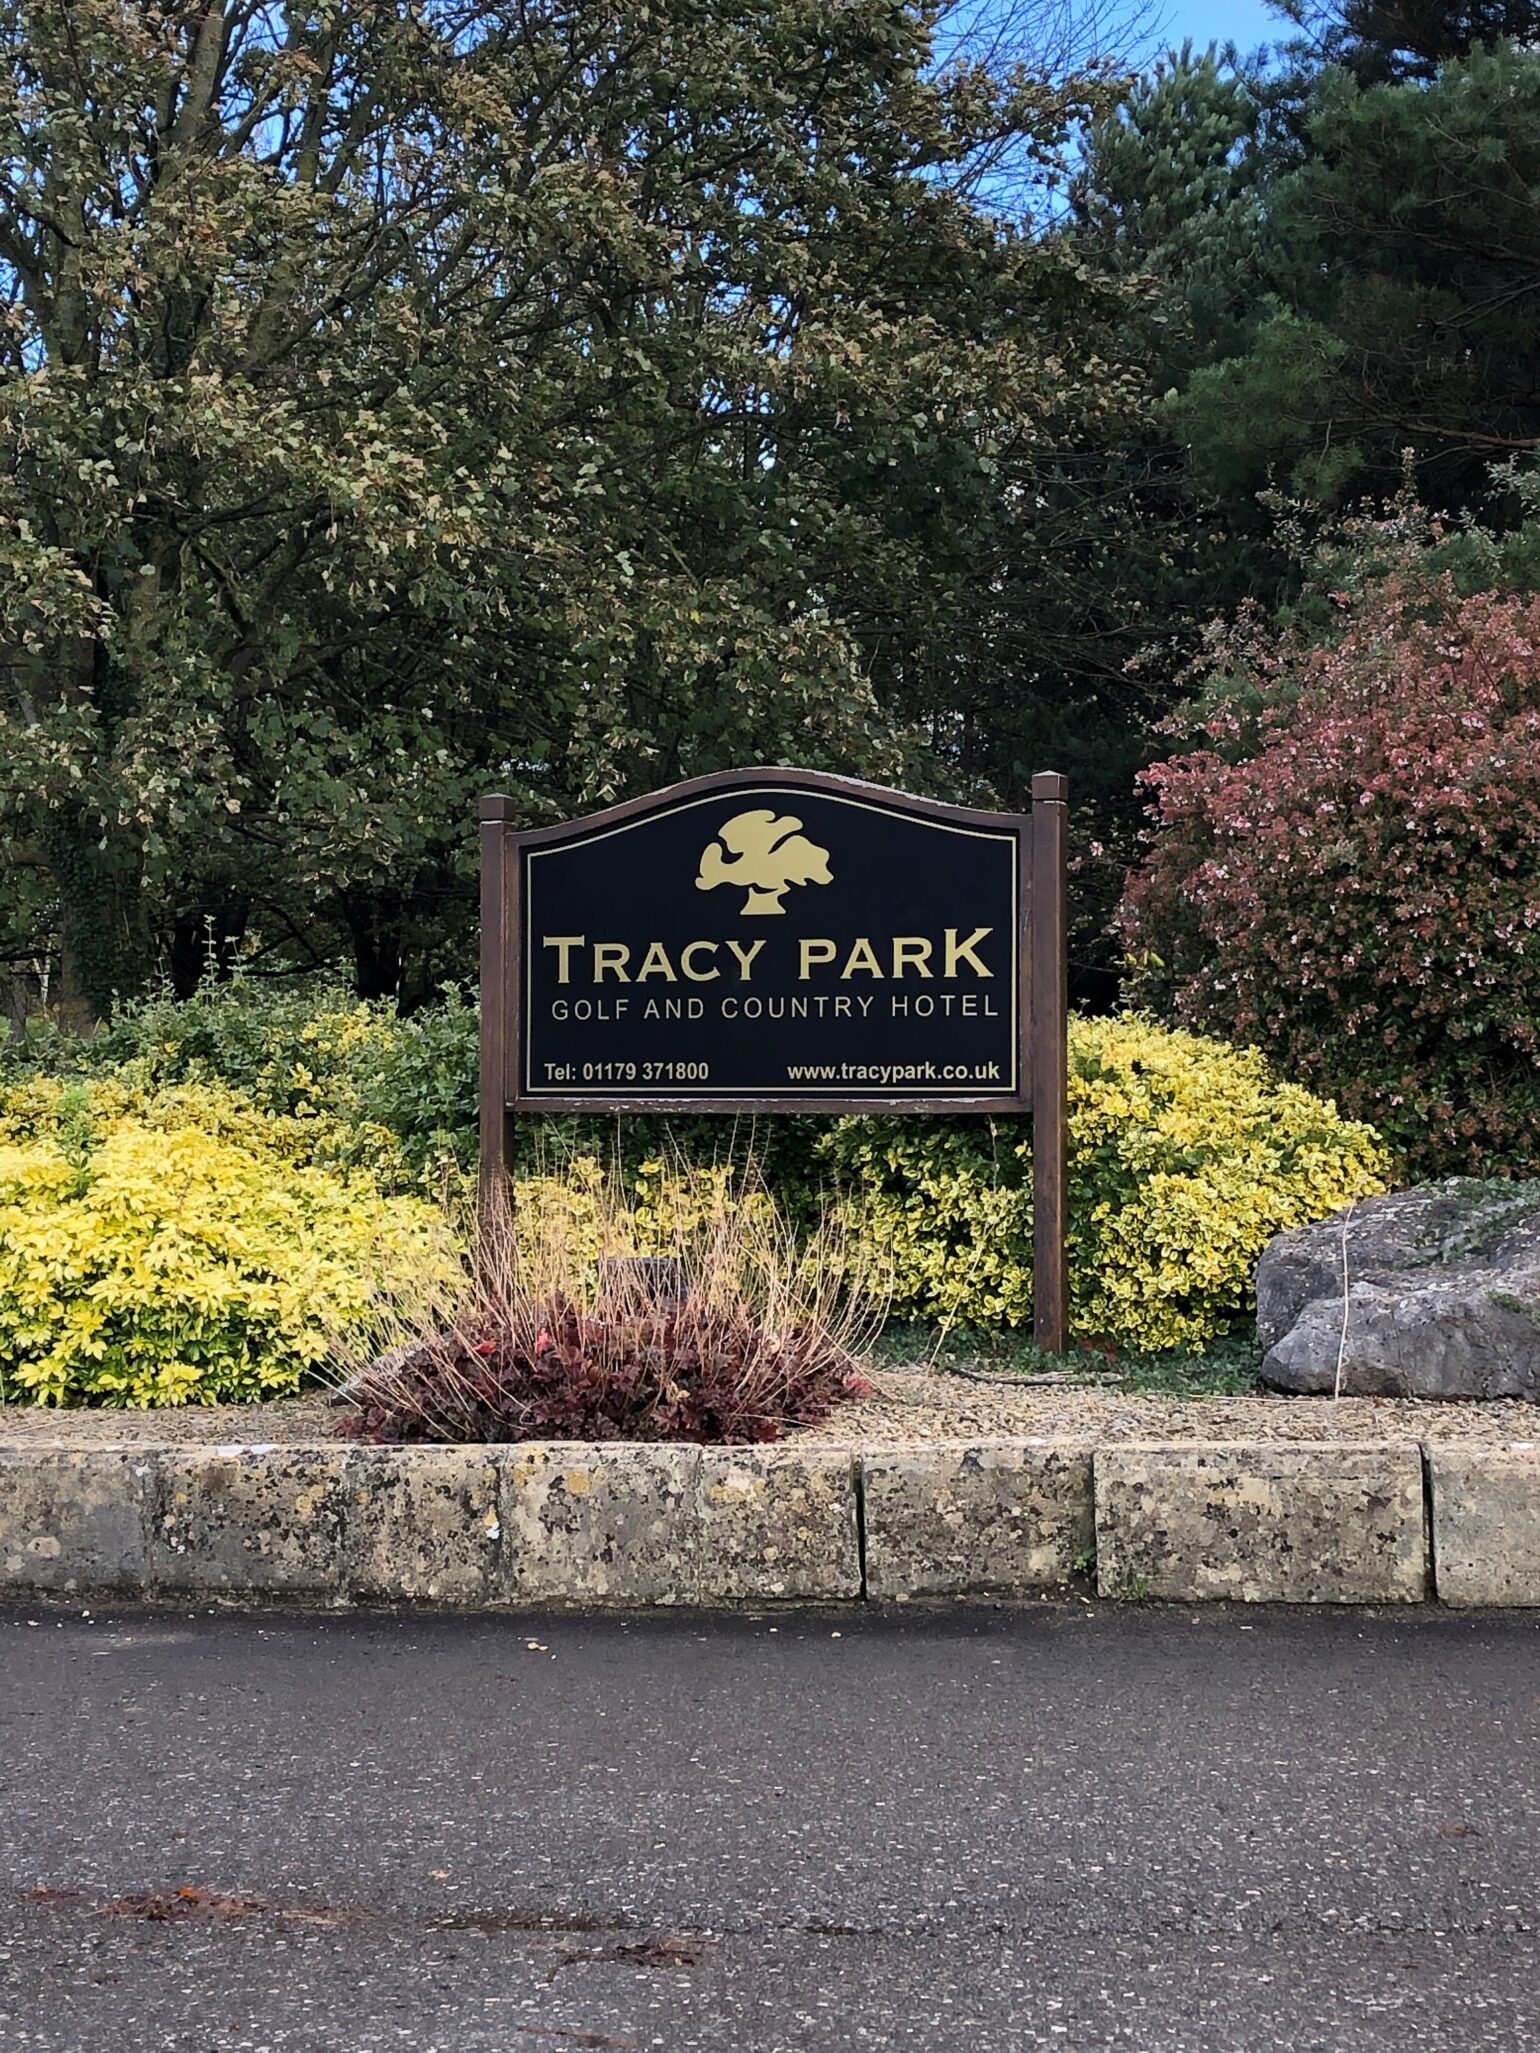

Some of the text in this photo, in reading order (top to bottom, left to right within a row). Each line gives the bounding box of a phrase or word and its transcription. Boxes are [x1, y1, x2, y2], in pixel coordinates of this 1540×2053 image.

[543, 927, 995, 984] TRACY PARK
[552, 994, 998, 1020] GOLF AND COUNTRY HOTEL
[544, 1062, 709, 1080] Tel: 01179 371800
[787, 1061, 1000, 1084] www.tracypark.co.uk
